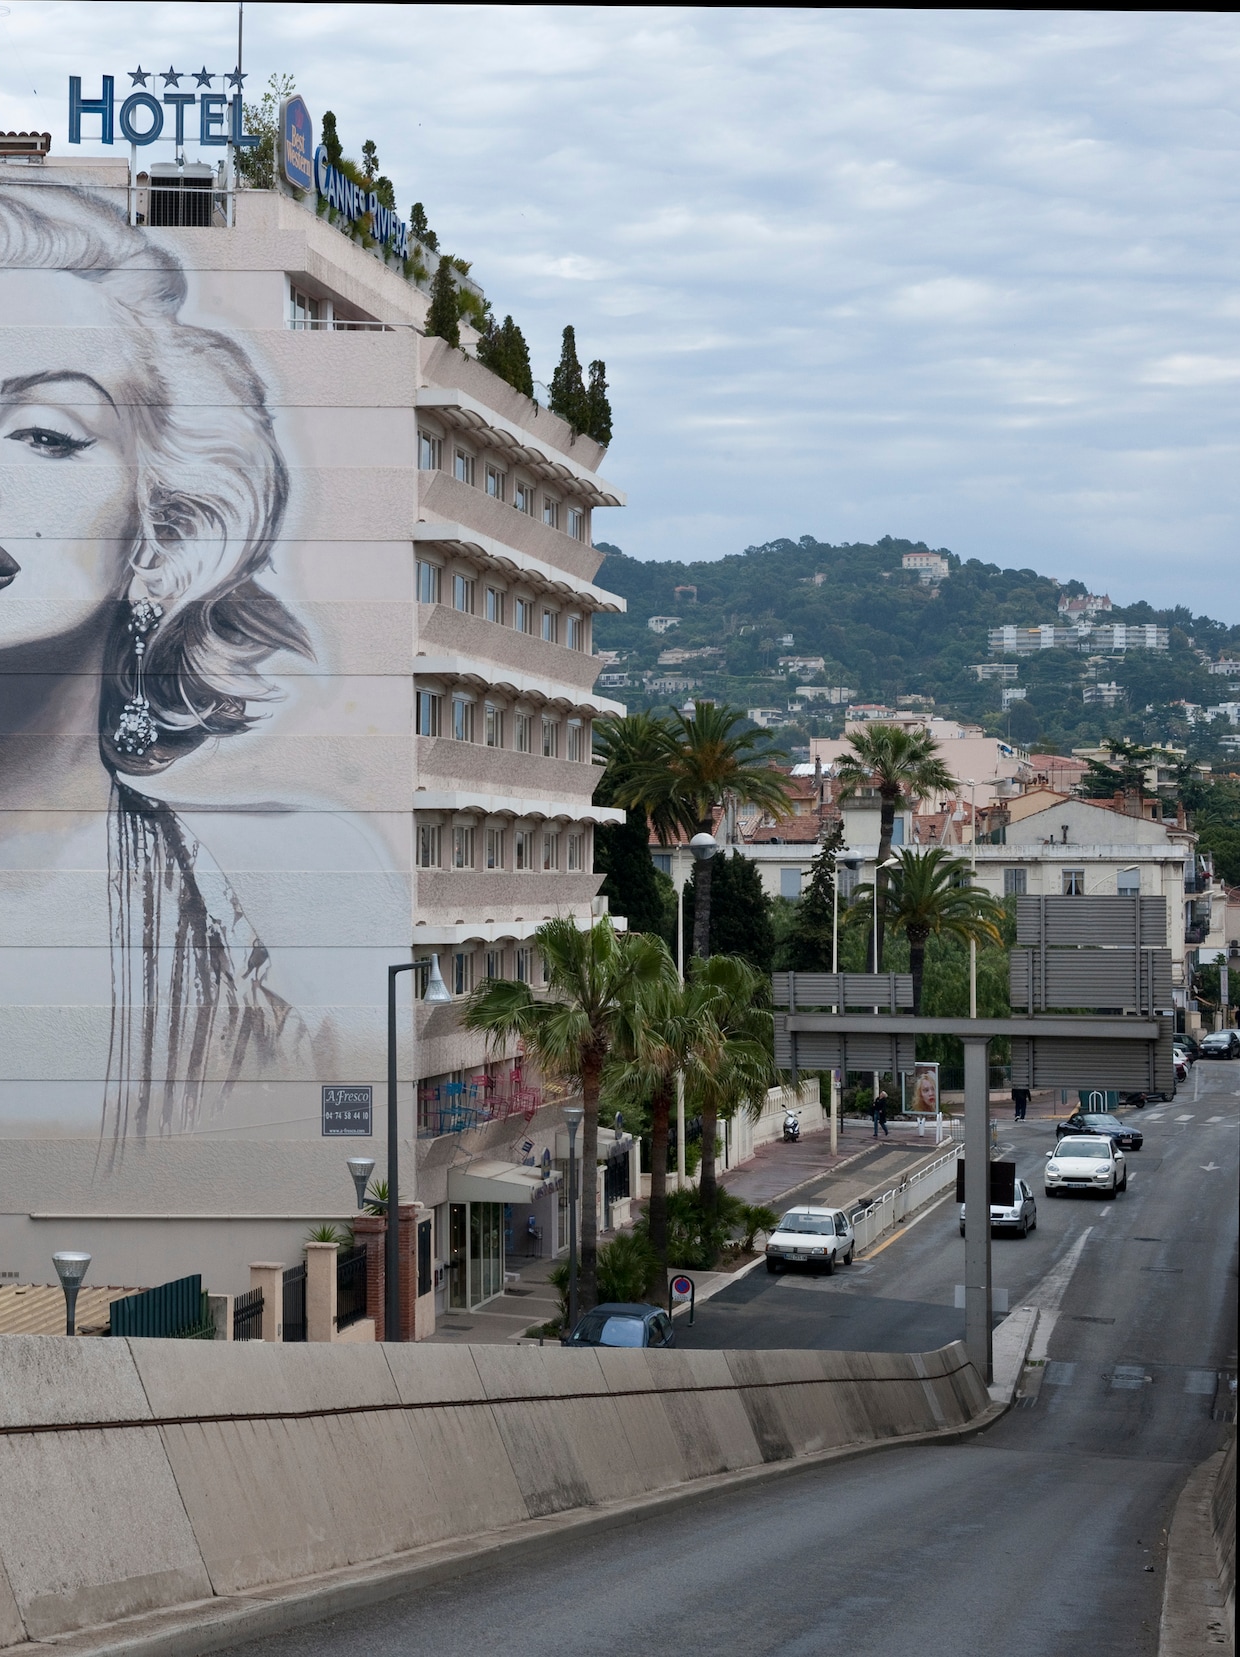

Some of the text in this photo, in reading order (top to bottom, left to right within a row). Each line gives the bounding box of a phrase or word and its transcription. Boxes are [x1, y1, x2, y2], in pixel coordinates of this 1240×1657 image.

[68, 75, 261, 146] HOTEL
[291, 124, 306, 154] Best
[286, 139, 311, 177] Western
[325, 1090, 369, 1106] A.Fresco
[326, 1112, 333, 1120] 04
[335, 1112, 342, 1120] 74
[353, 1112, 361, 1120] 44
[362, 1112, 369, 1120] 10
